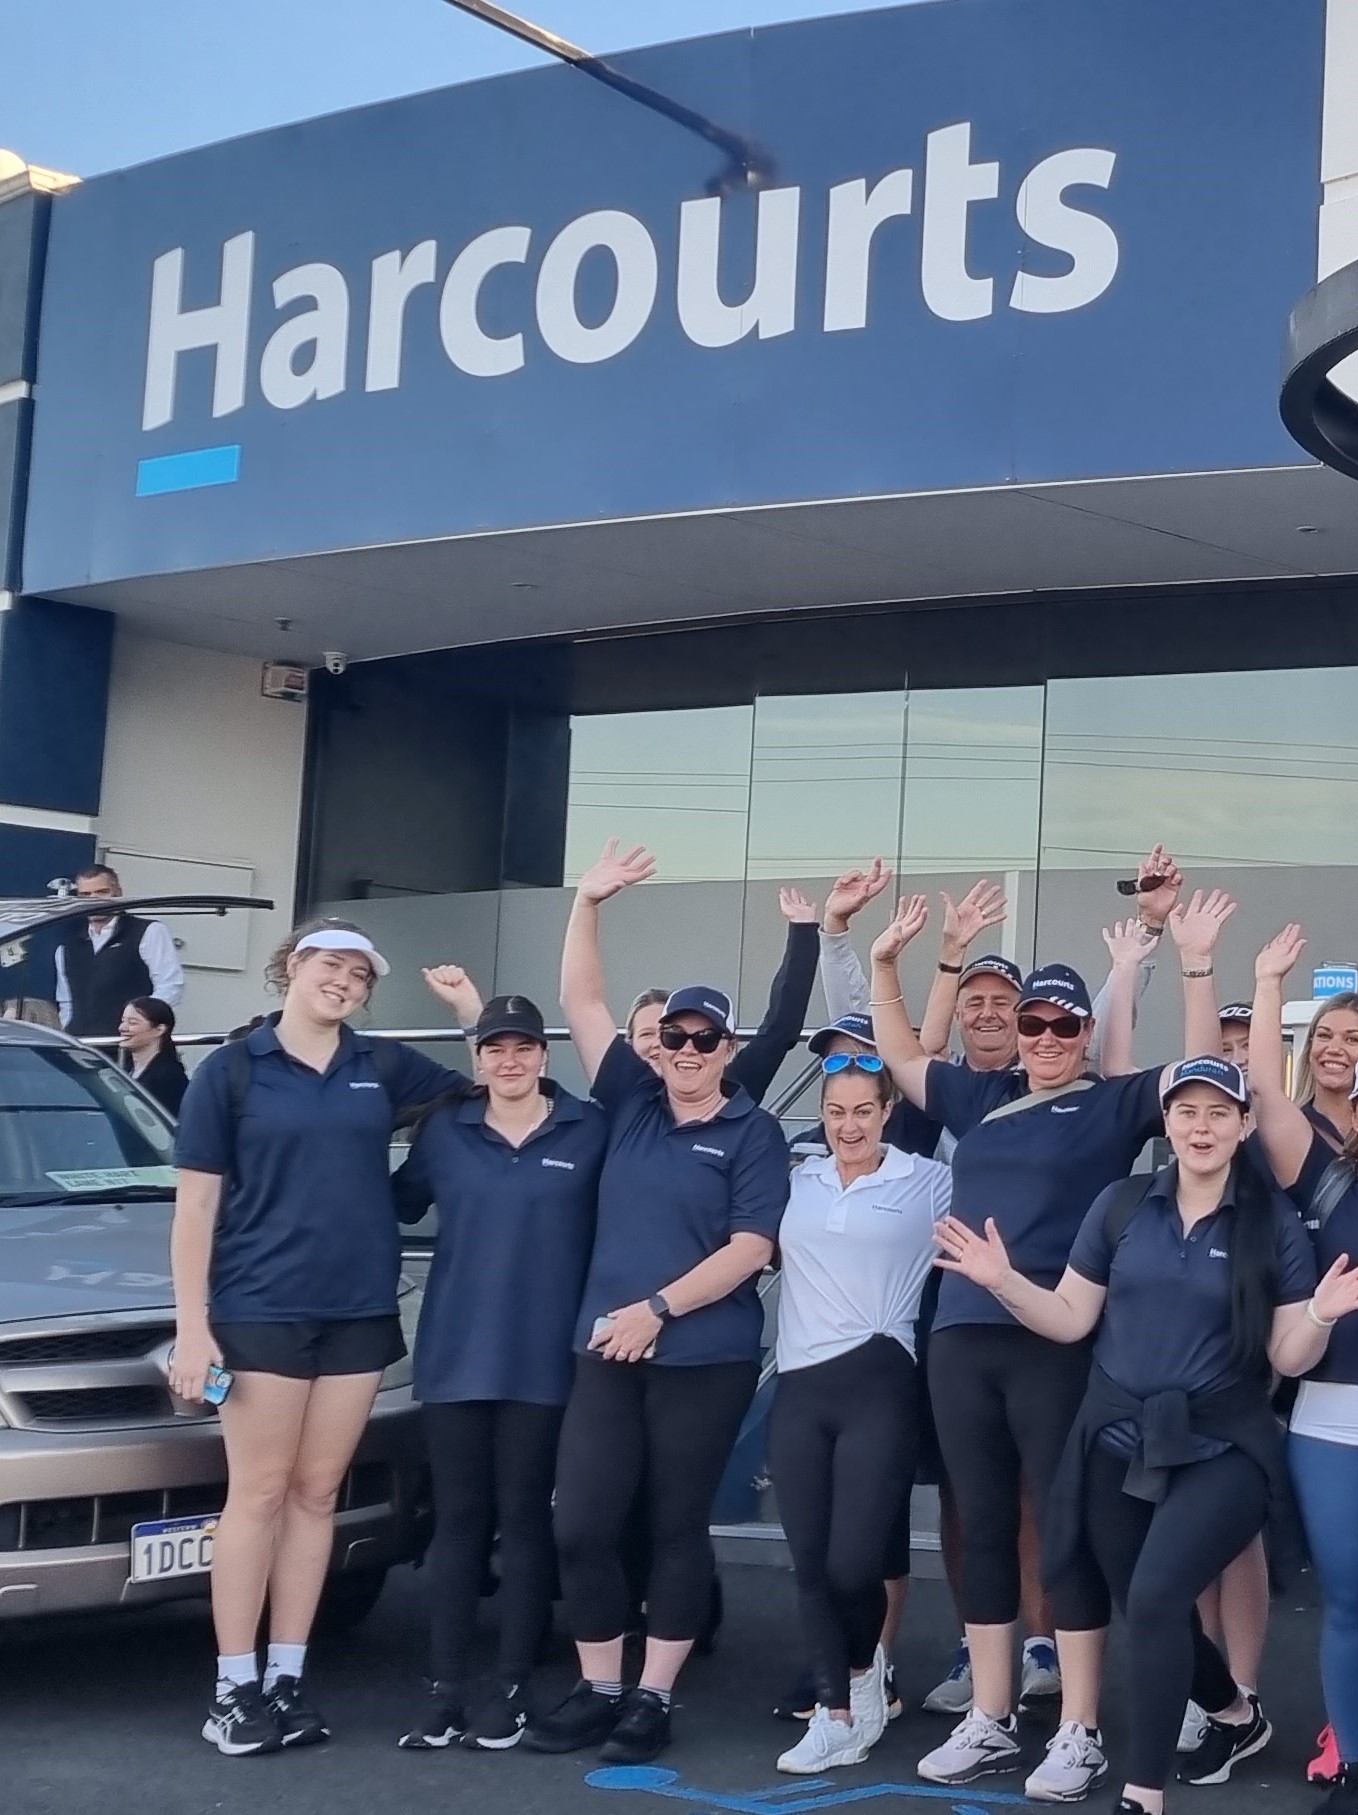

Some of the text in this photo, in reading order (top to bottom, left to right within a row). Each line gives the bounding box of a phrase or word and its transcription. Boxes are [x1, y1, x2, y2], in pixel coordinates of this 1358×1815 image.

[142, 121, 1119, 431] Harcourts
[1032, 978, 1075, 991] Harcourts
[1181, 1059, 1229, 1072] Harcourts
